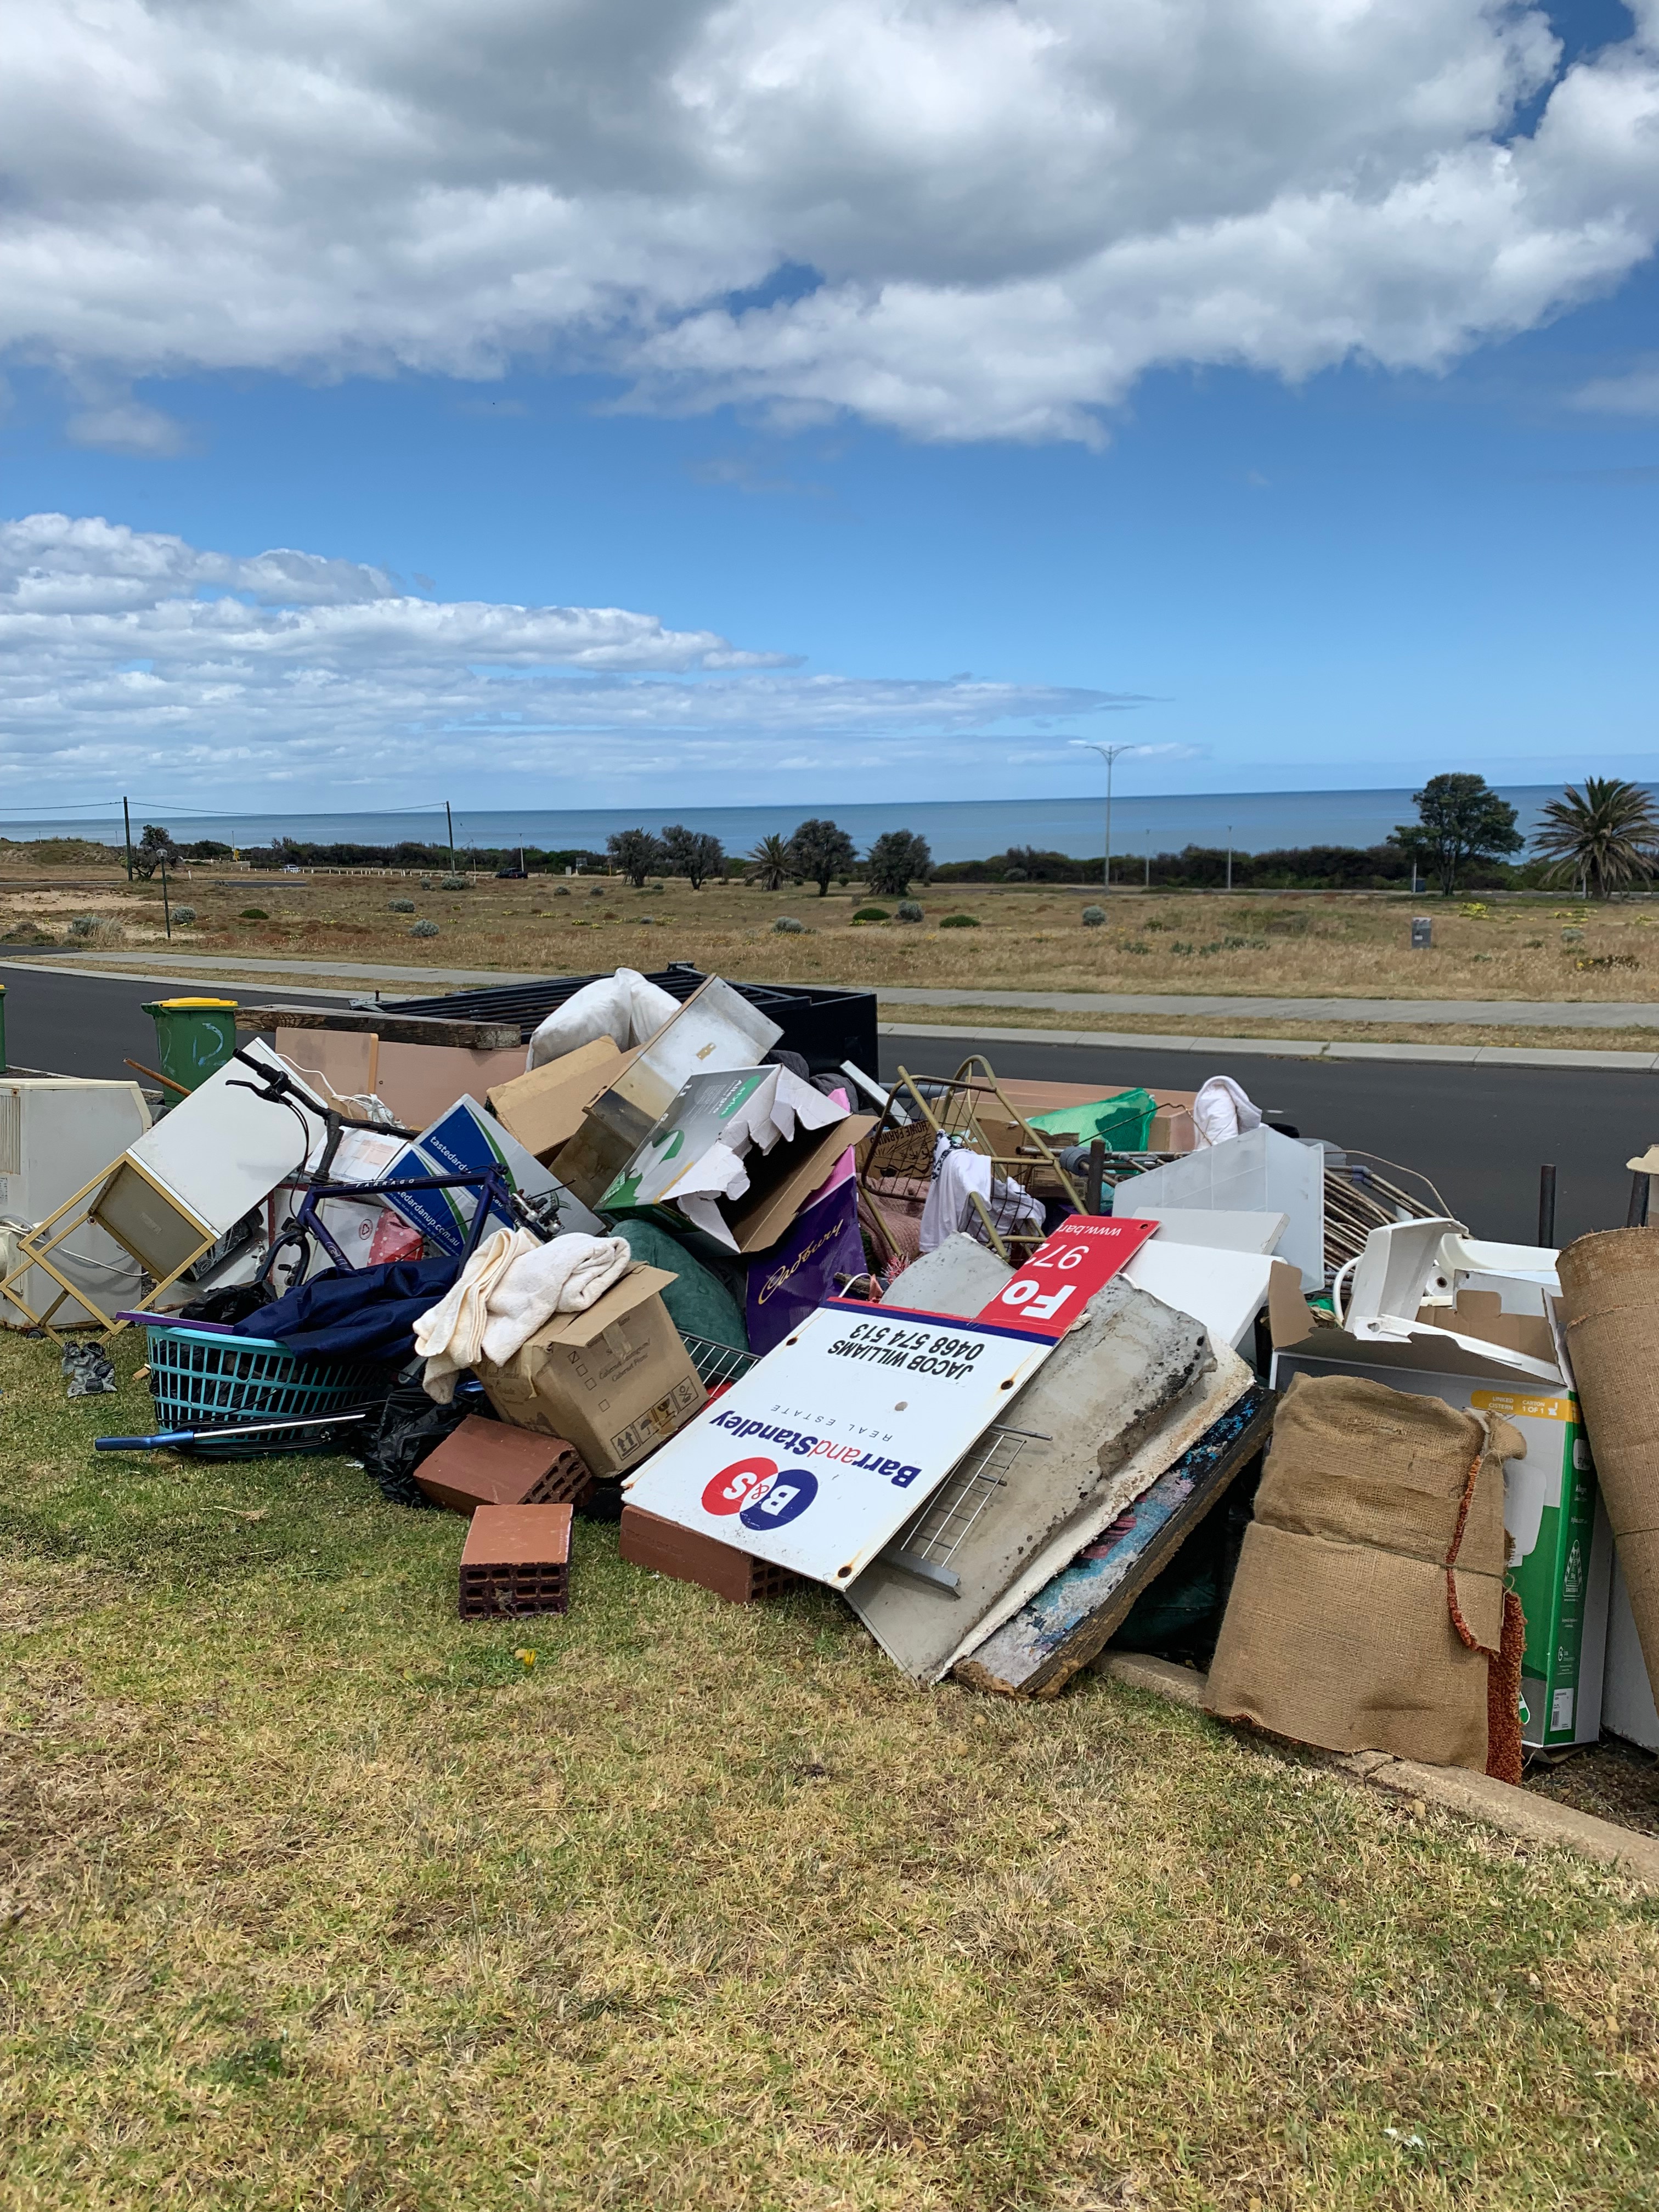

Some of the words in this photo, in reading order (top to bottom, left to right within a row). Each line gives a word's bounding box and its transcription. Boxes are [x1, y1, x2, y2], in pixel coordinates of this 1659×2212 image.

[356, 1178, 415, 1188] FARRAGO
[758, 1218, 844, 1305] Cadbury
[849, 1323, 891, 1343] 513
[887, 1329, 931, 1351] 574
[827, 1340, 910, 1368] WILLIAMS
[928, 1336, 985, 1361] 0468
[906, 1355, 974, 1380] JACOB
[770, 1404, 837, 1426] ESTATE
[1488, 1402, 1514, 1410] CISTERN
[849, 1424, 893, 1442] REAL
[709, 1410, 923, 1488] BarrandStandley
